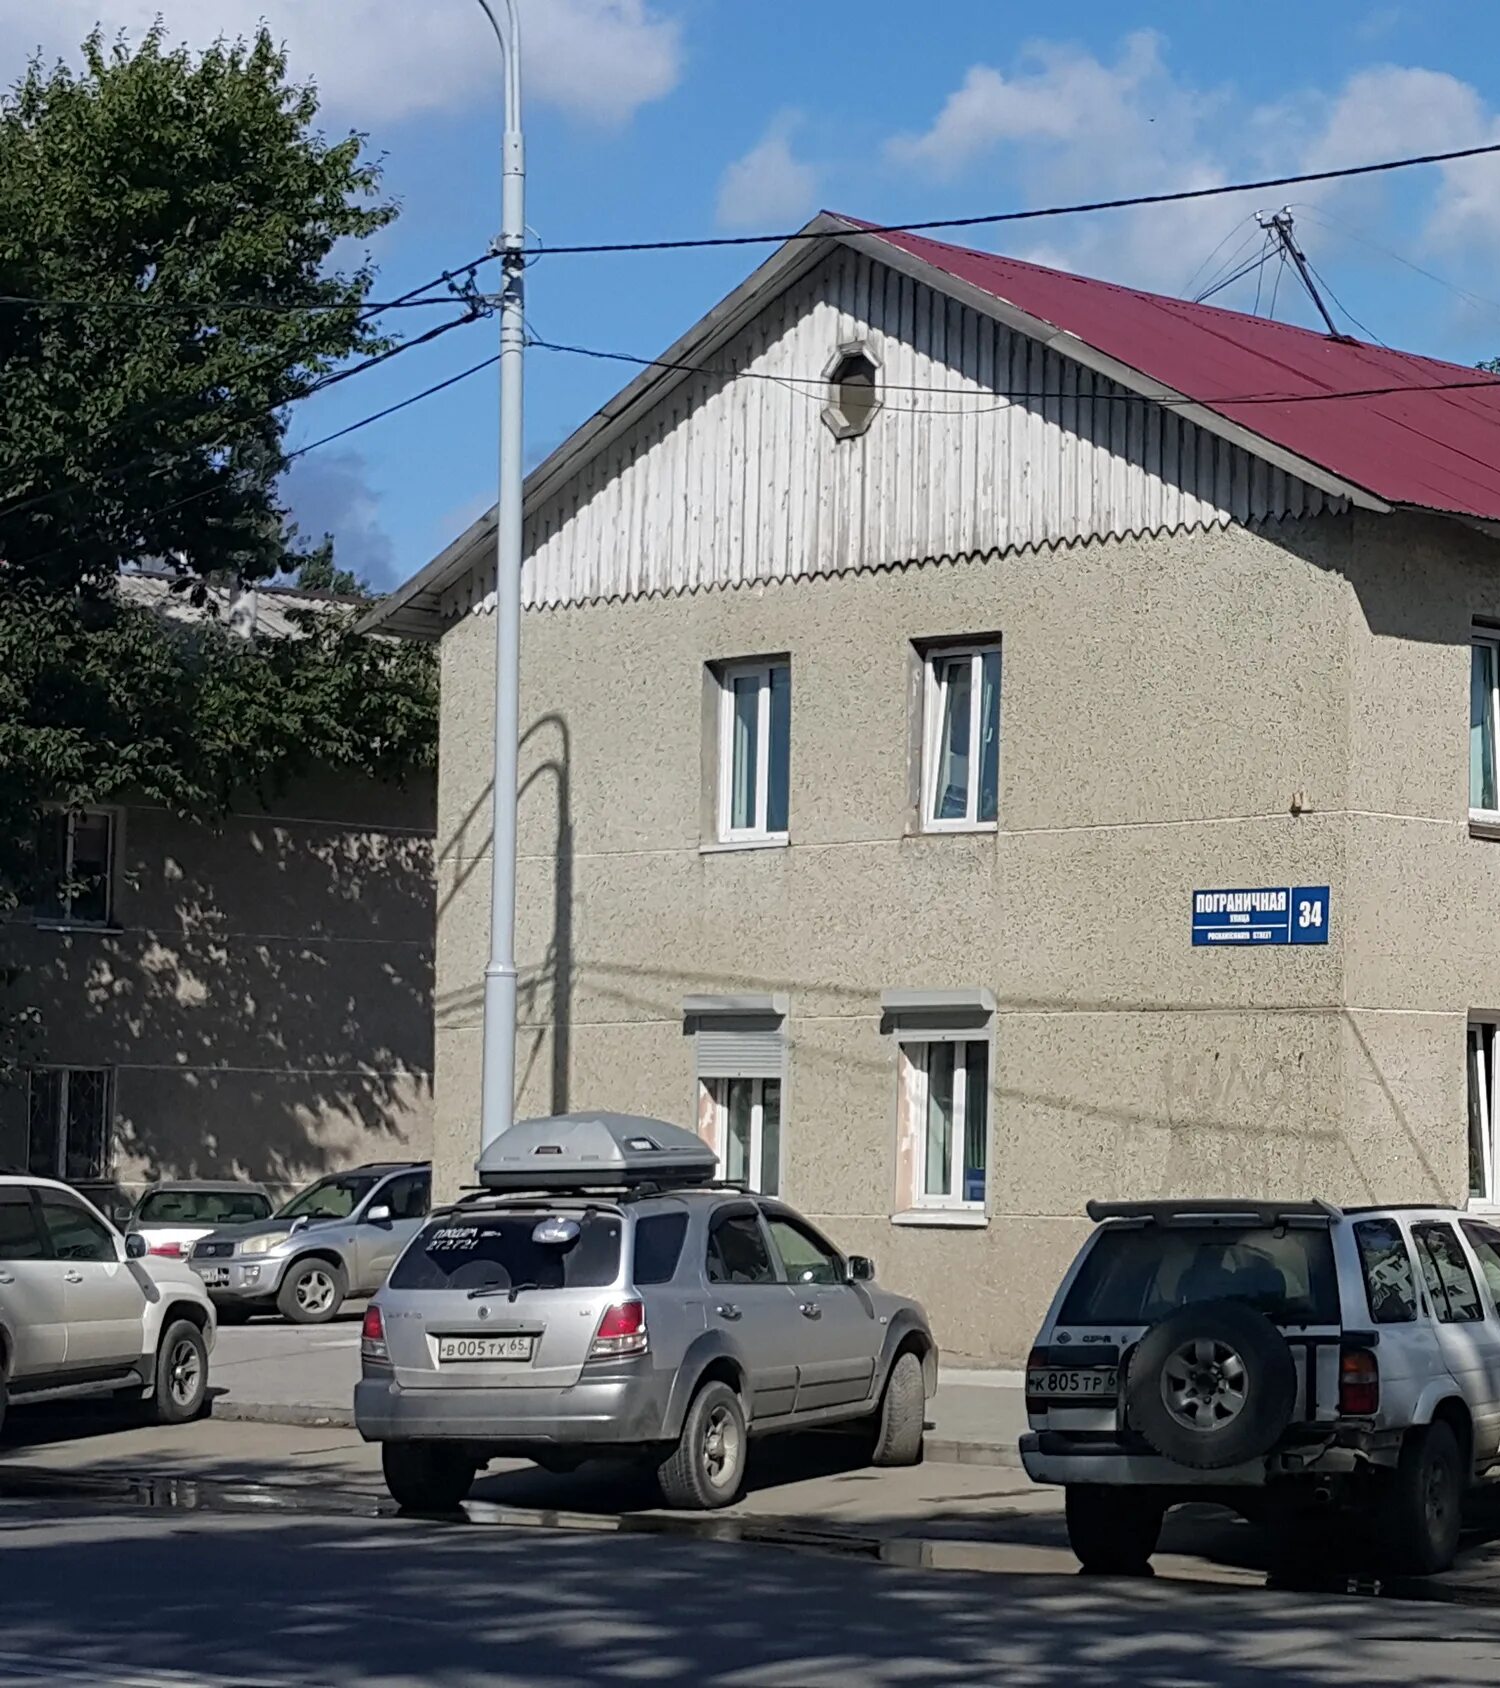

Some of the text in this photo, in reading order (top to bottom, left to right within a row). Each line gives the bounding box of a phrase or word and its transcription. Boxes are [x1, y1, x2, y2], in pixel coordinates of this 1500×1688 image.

[1196, 891, 1287, 913] ПОГРАНИЧНАЯ
[1299, 901, 1323, 928] 34
[446, 1339, 525, 1356] В005ТХ 65
[1036, 1373, 1103, 1391] К805ТР
